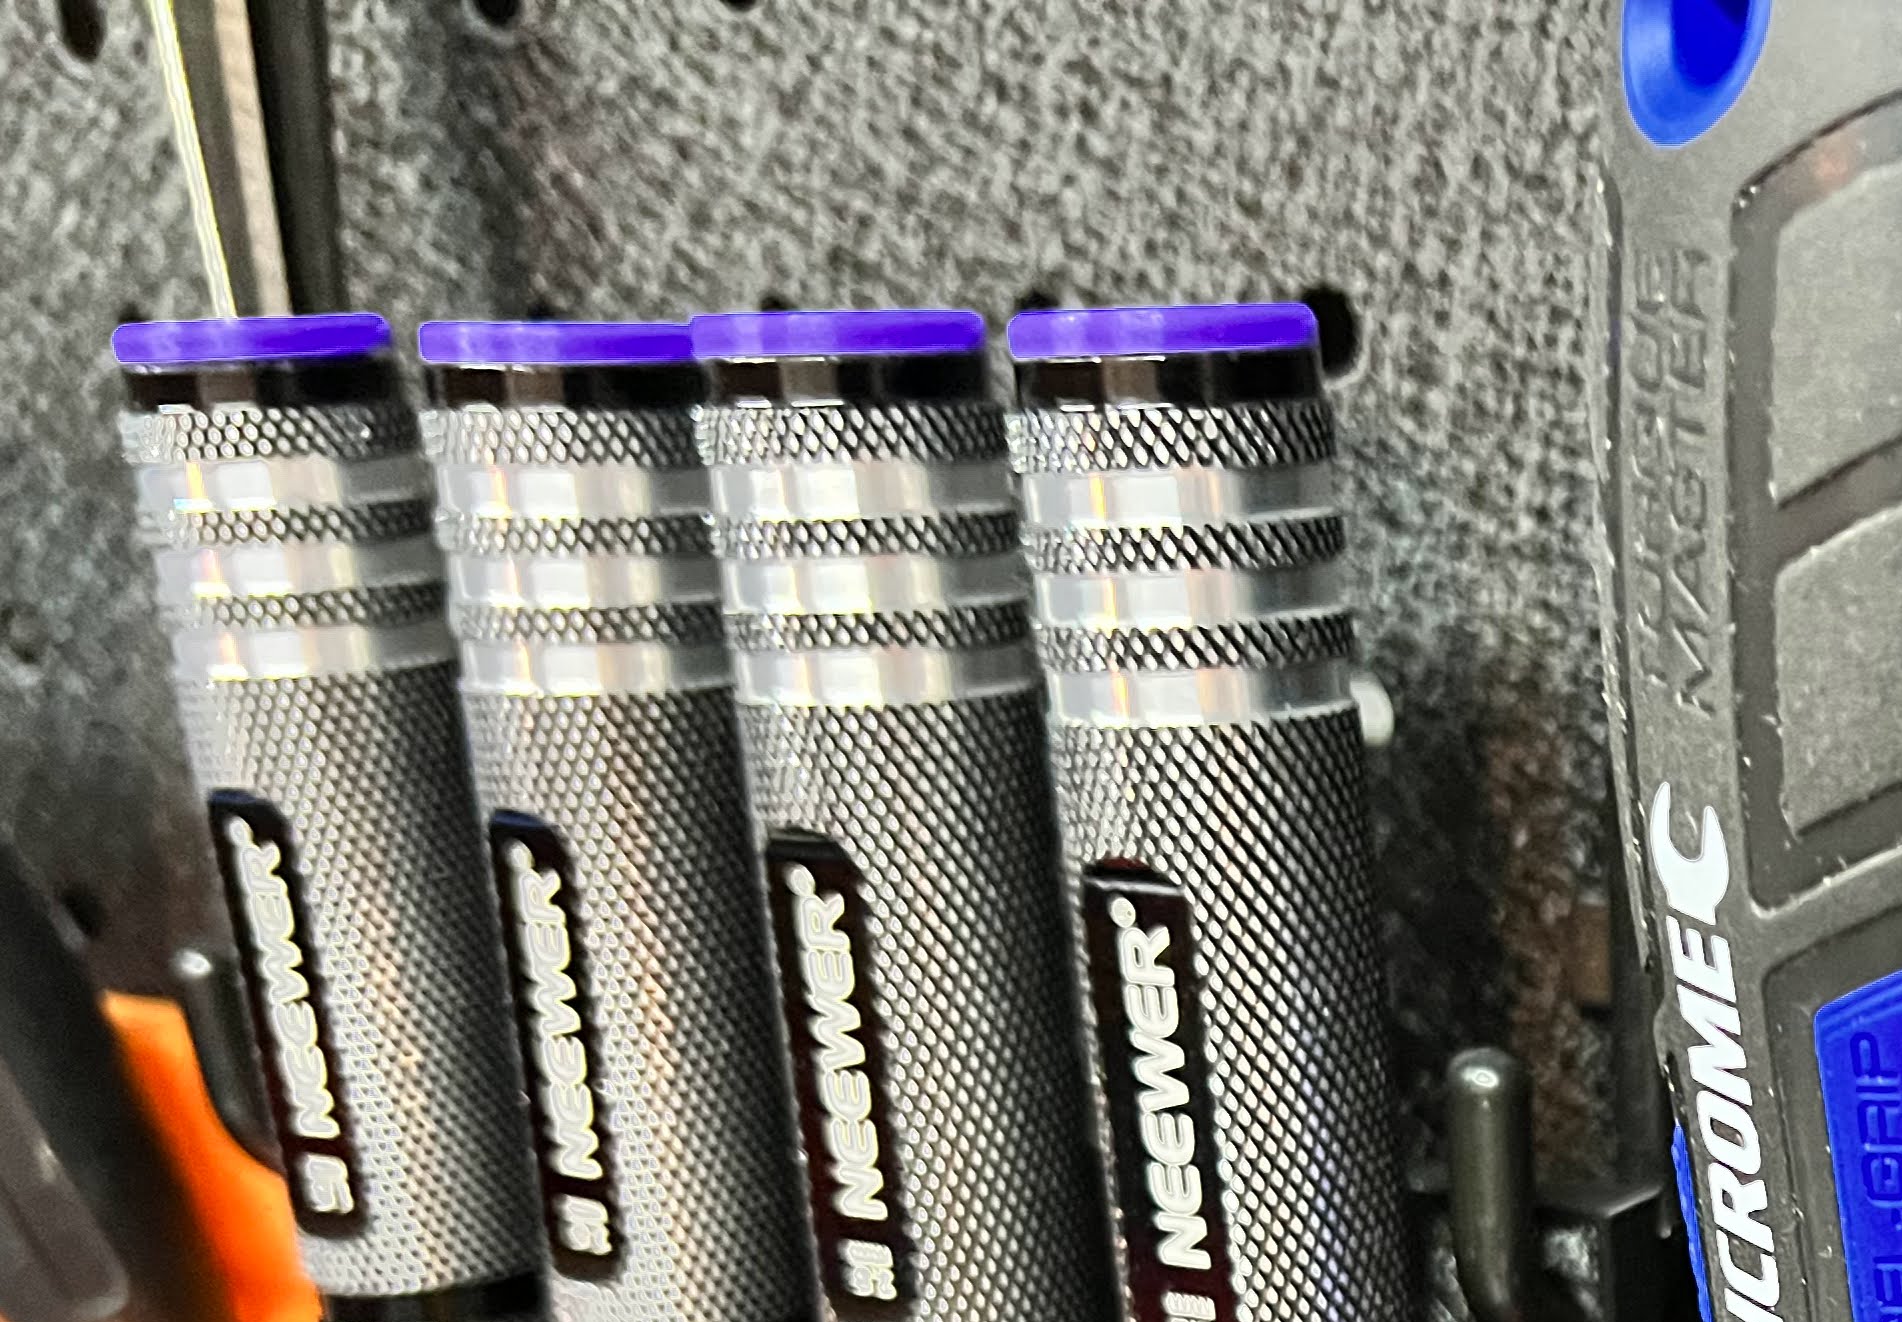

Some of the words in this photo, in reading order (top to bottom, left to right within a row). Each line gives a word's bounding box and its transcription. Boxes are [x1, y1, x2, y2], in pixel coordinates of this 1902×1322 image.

[1626, 247, 1668, 683] TORQUE
[1670, 247, 1714, 718] MASTER
[230, 840, 340, 1138] NEEWER
[519, 867, 604, 1180] NEEWER
[797, 891, 888, 1221] NEEWER
[1116, 924, 1213, 1270] NEEWER
